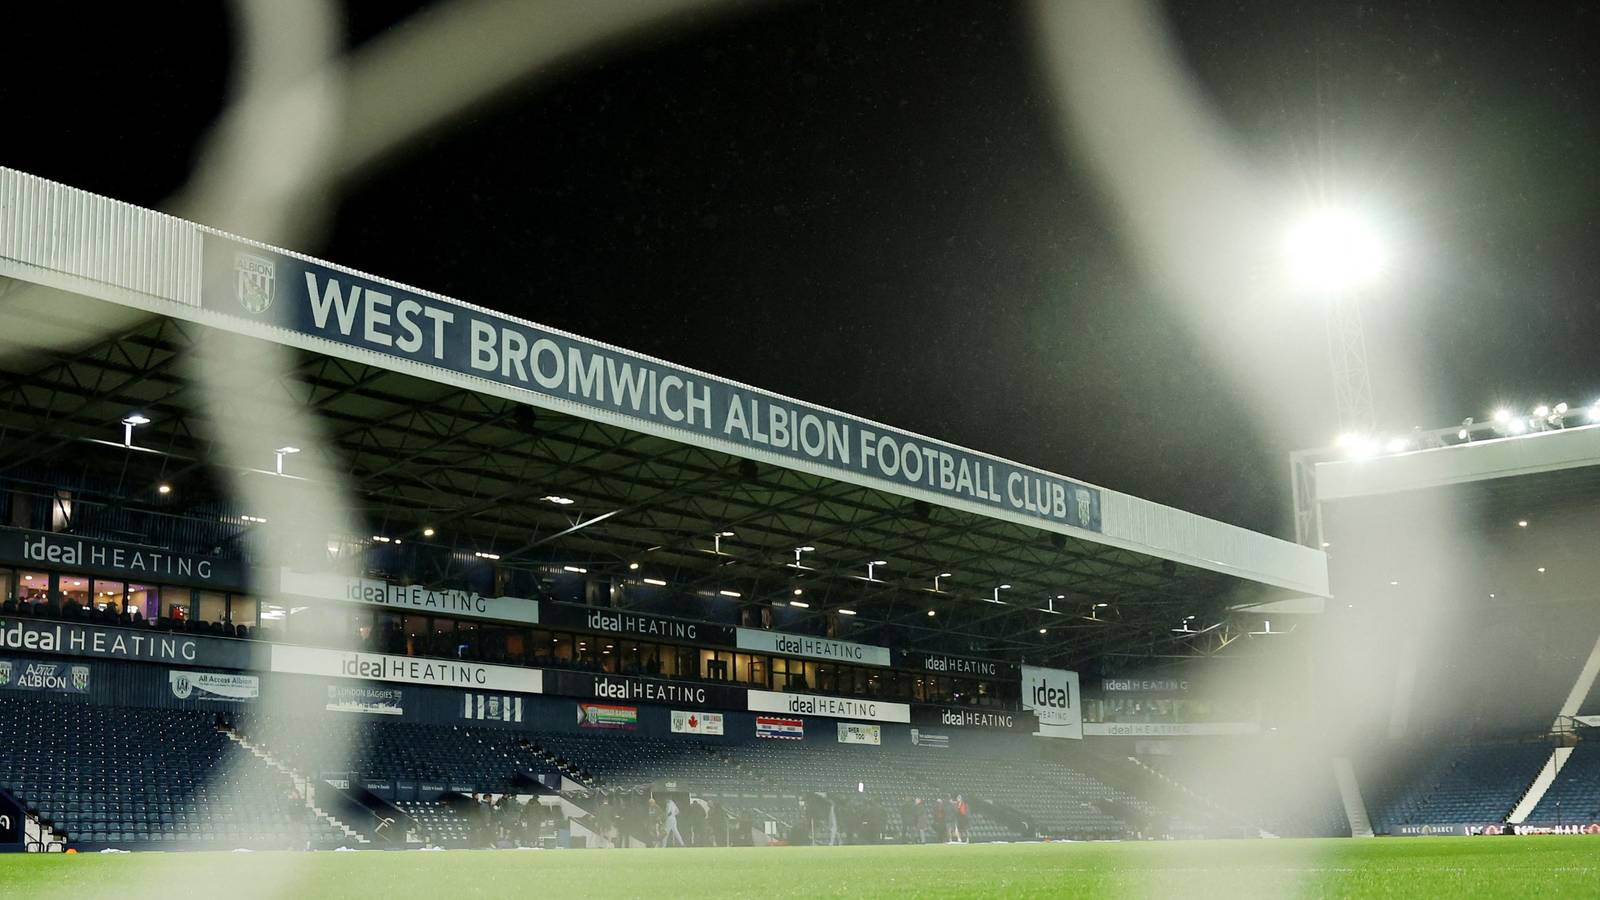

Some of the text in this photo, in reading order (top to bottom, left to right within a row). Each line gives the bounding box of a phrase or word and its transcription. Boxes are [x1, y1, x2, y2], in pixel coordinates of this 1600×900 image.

[238, 257, 273, 278] ALBION
[305, 271, 1067, 519] WEST BROMWICH ALBION FOOTBALL CLUB
[23, 535, 212, 579] ideal HEATING
[346, 580, 487, 613] ideal HEATING
[588, 611, 697, 640] ideal HEATING
[0, 620, 198, 661] ideal HEATING
[775, 634, 863, 660] ideal HEATING
[341, 652, 487, 685] ideal HEATING
[925, 655, 996, 676] ideal HEATING
[17, 673, 67, 689] ALBION
[594, 676, 705, 704] ideal HEATING
[1032, 677, 1071, 709] ideal
[1105, 680, 1131, 691] ideal
[788, 695, 876, 717] ideal HEATING
[942, 707, 1012, 728] ideal HEATING
